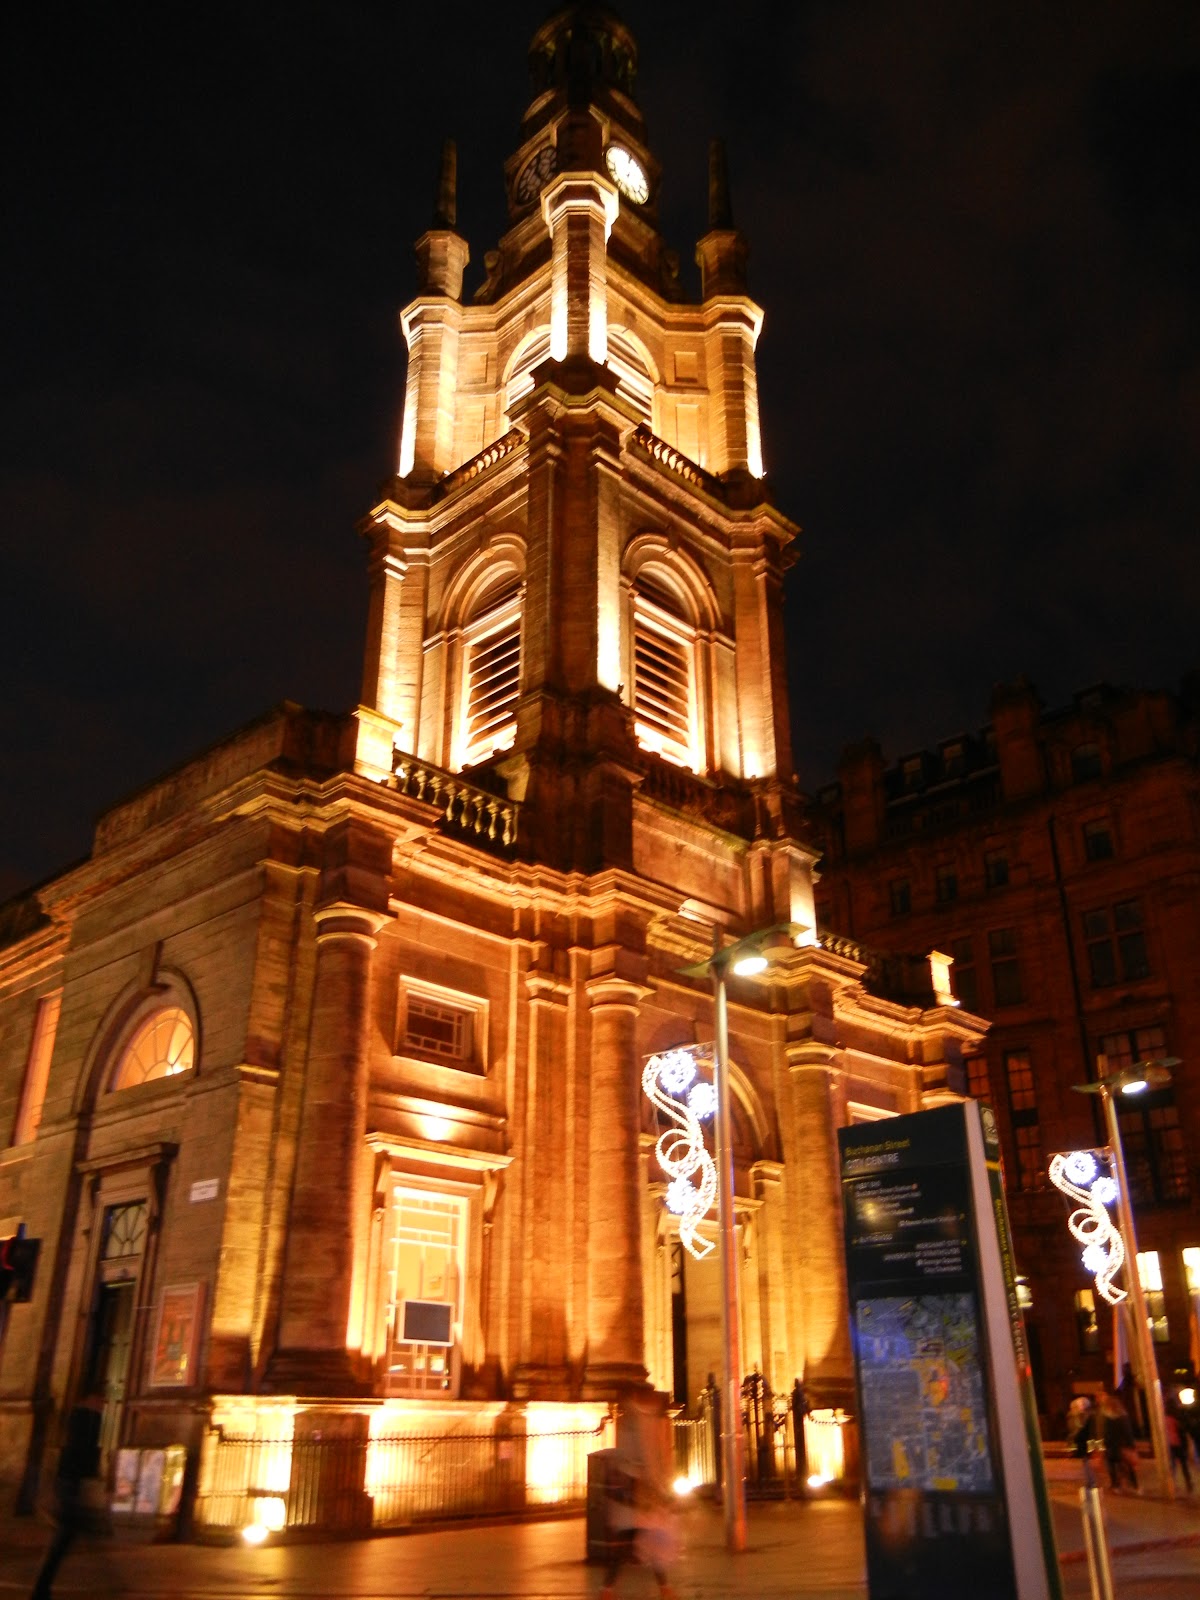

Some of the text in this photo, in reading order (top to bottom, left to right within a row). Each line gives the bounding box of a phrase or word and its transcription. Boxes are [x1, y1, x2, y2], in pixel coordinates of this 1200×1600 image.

[846, 1152, 899, 1170] CITY CENTRE
[885, 1139, 911, 1151] Street
[995, 1199, 1007, 1251] Buchanan
[1013, 1321, 1025, 1369] CENTRE
